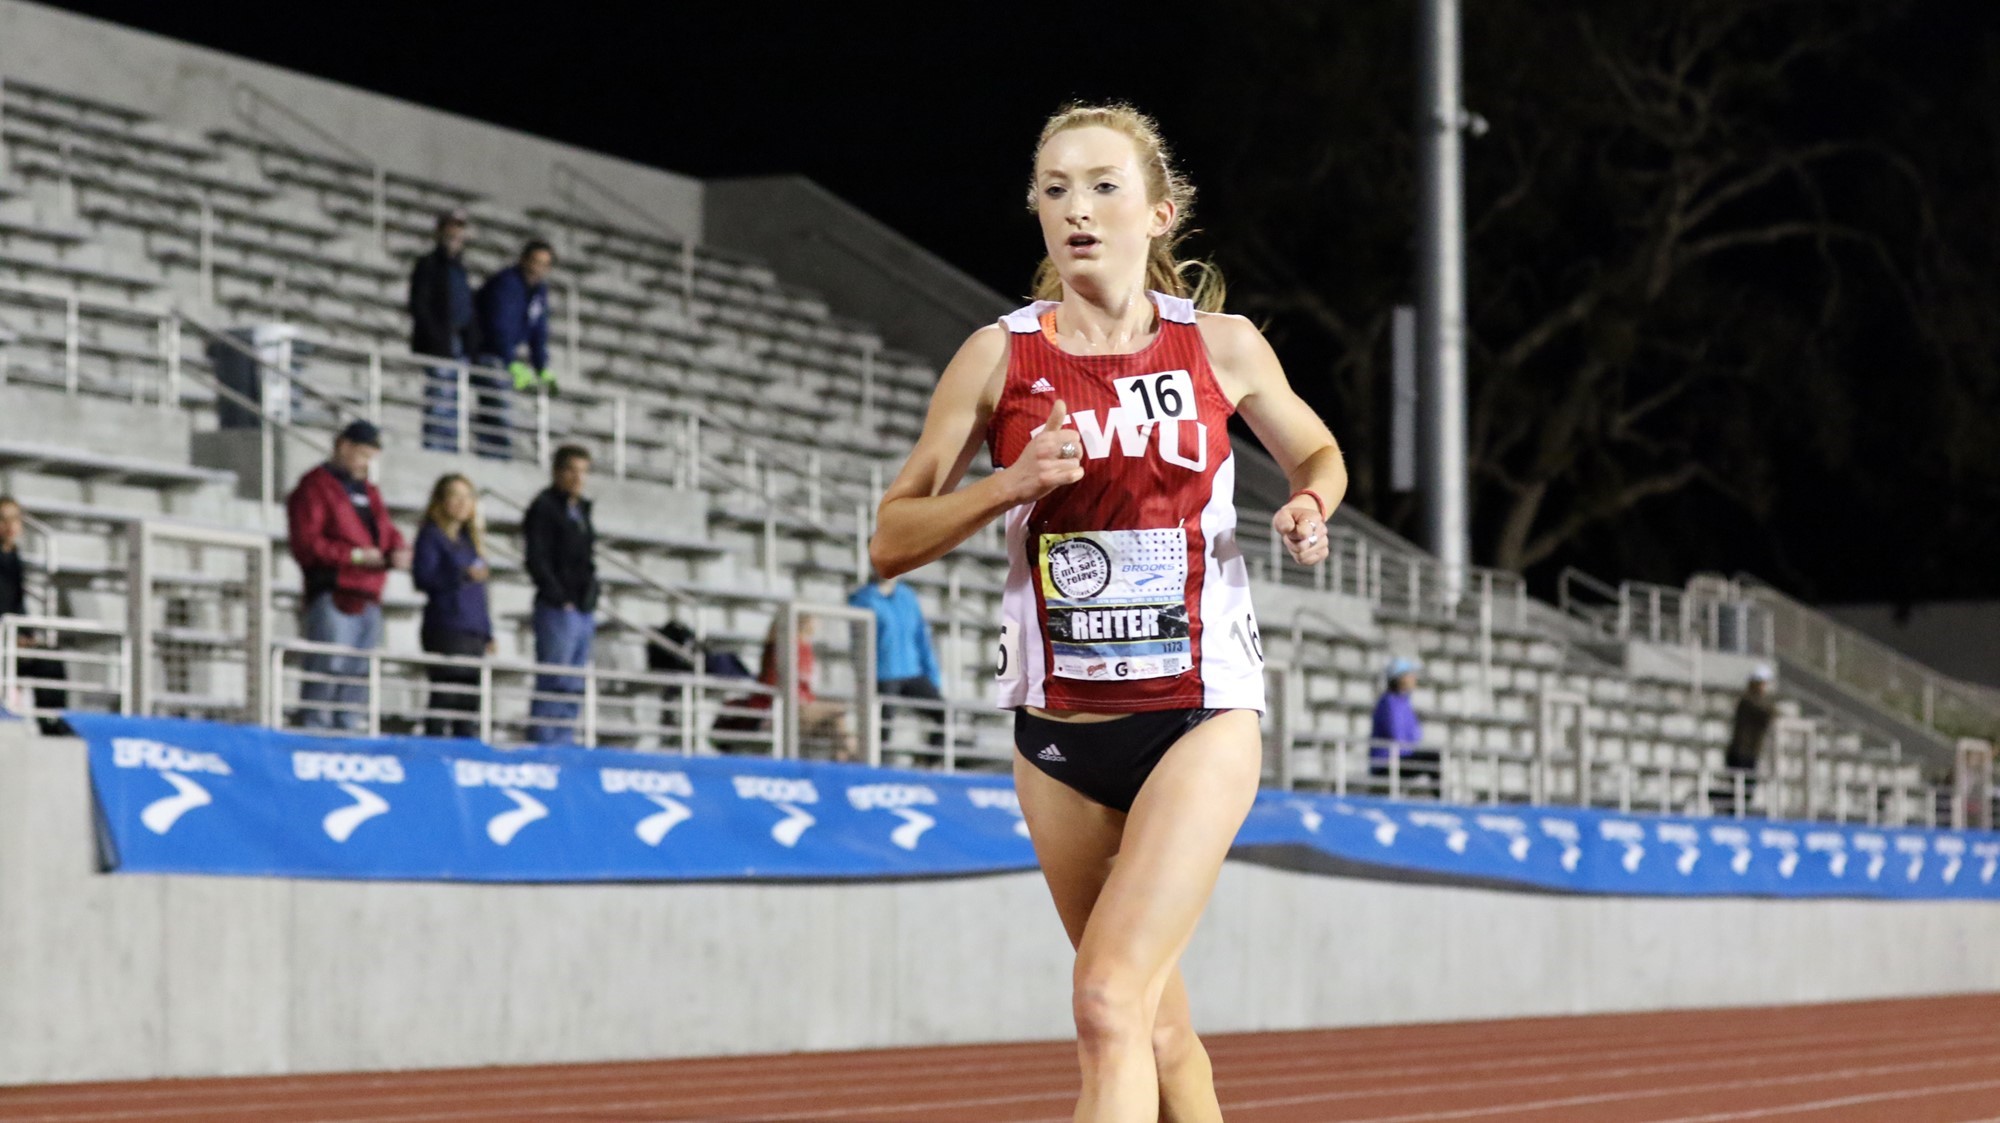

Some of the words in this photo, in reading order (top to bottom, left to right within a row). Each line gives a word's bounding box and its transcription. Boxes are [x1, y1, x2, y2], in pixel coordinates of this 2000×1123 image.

[1130, 374, 1183, 420] 16
[1079, 560, 1097, 571] sac
[1122, 563, 1176, 572] BROOKS
[1071, 609, 1160, 640] REITER
[1163, 641, 1184, 653] 1173
[292, 751, 405, 783] BROOKS
